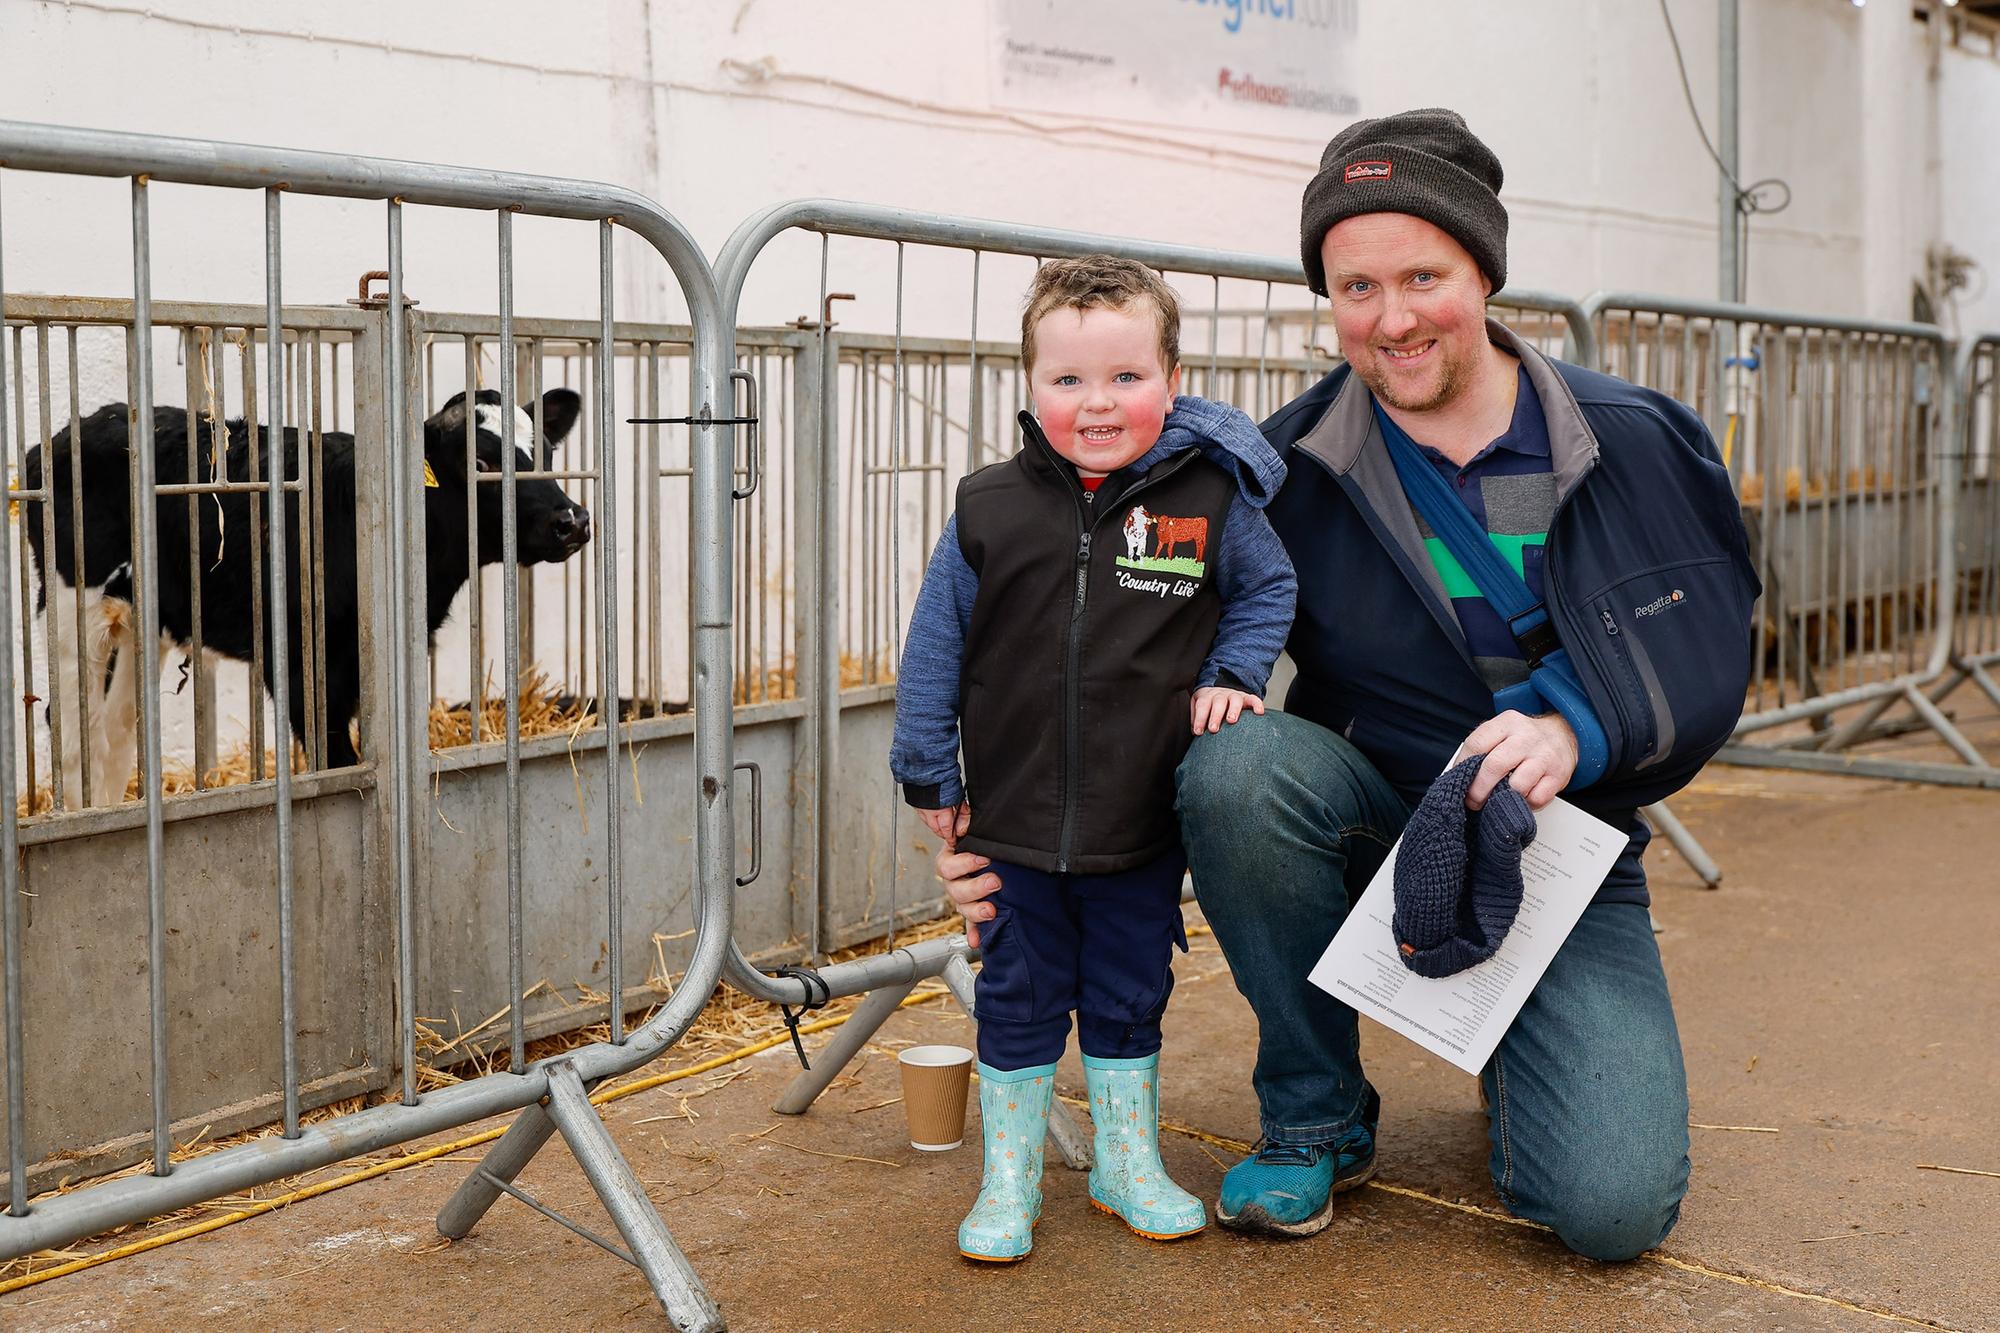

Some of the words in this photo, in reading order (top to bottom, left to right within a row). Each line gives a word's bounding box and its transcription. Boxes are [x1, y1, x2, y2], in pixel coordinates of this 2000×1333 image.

[1115, 570, 1171, 599] "Country
[1172, 579, 1200, 598] Life"
[1634, 594, 1672, 619] Regatta
